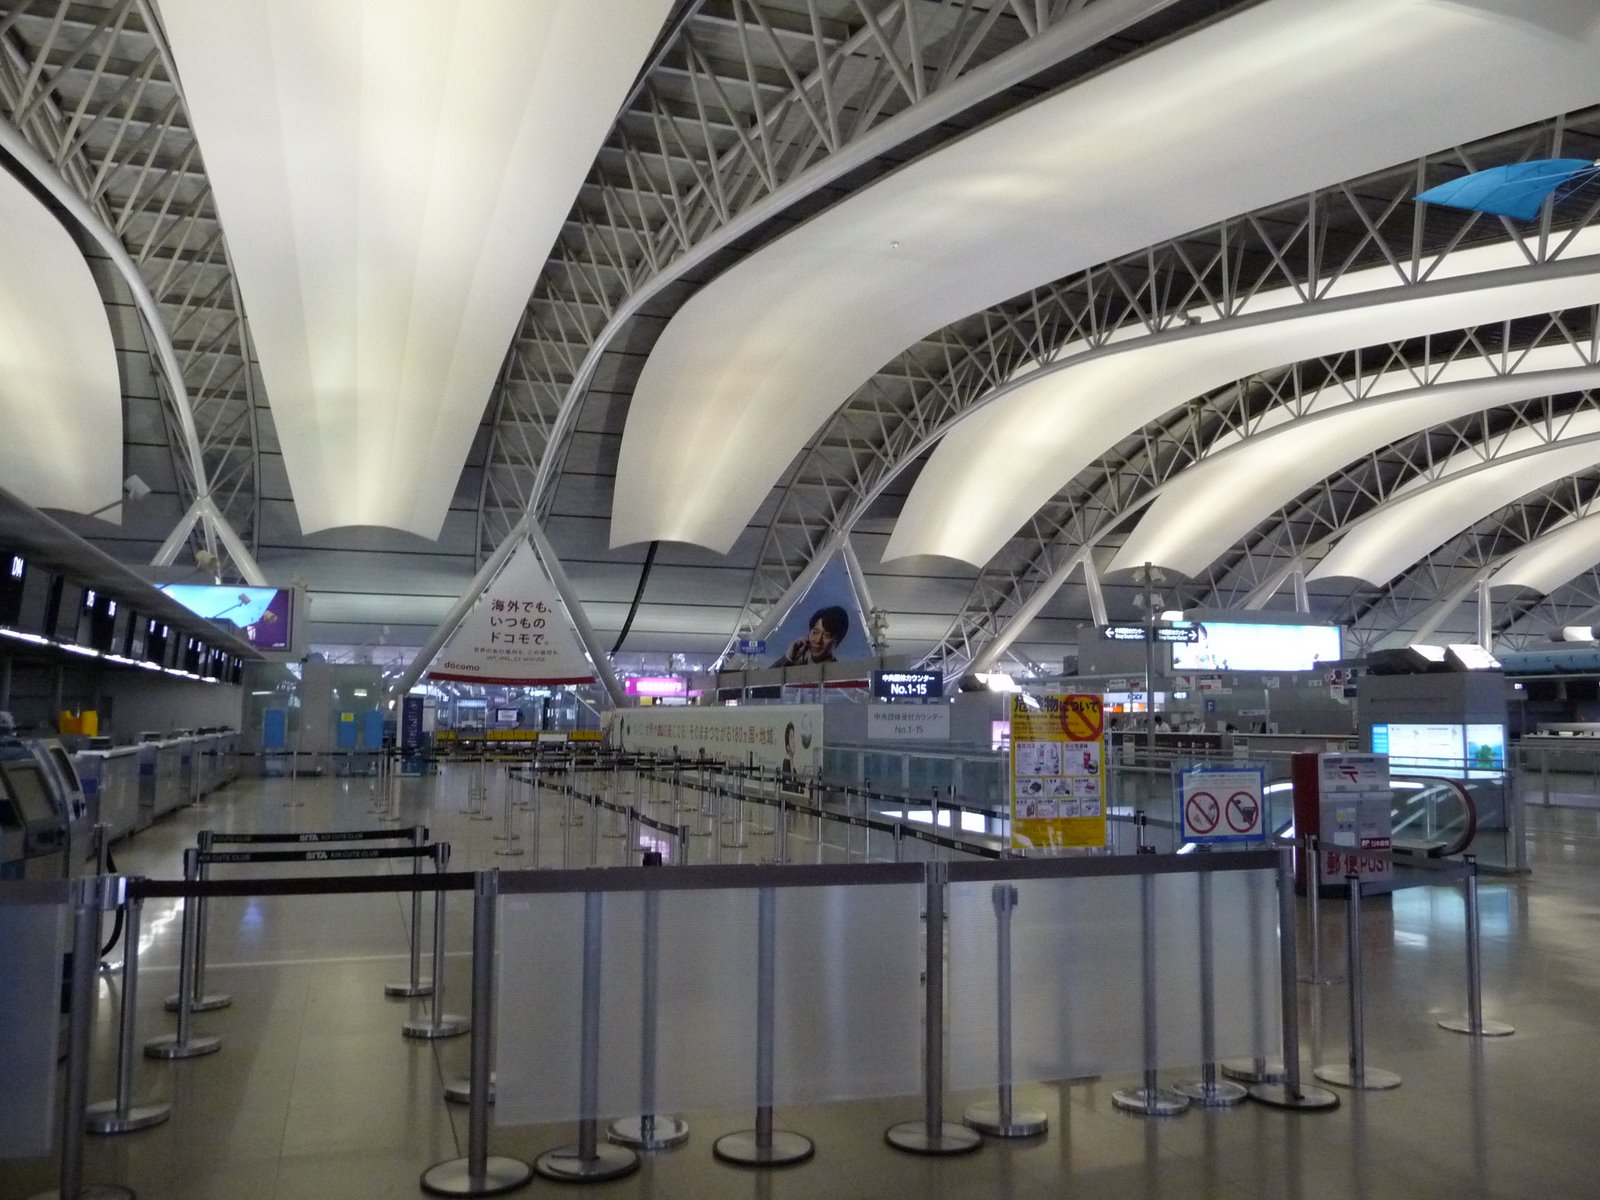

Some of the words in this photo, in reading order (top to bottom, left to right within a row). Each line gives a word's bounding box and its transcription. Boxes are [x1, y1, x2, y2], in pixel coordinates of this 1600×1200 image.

[491, 599, 552, 613] 海外でも、
[490, 616, 546, 629] いつもの
[490, 631, 549, 646] ドコモで。
[444, 661, 480, 672] docomo
[890, 683, 927, 695] No.1-15
[895, 725, 924, 734] No.1-15
